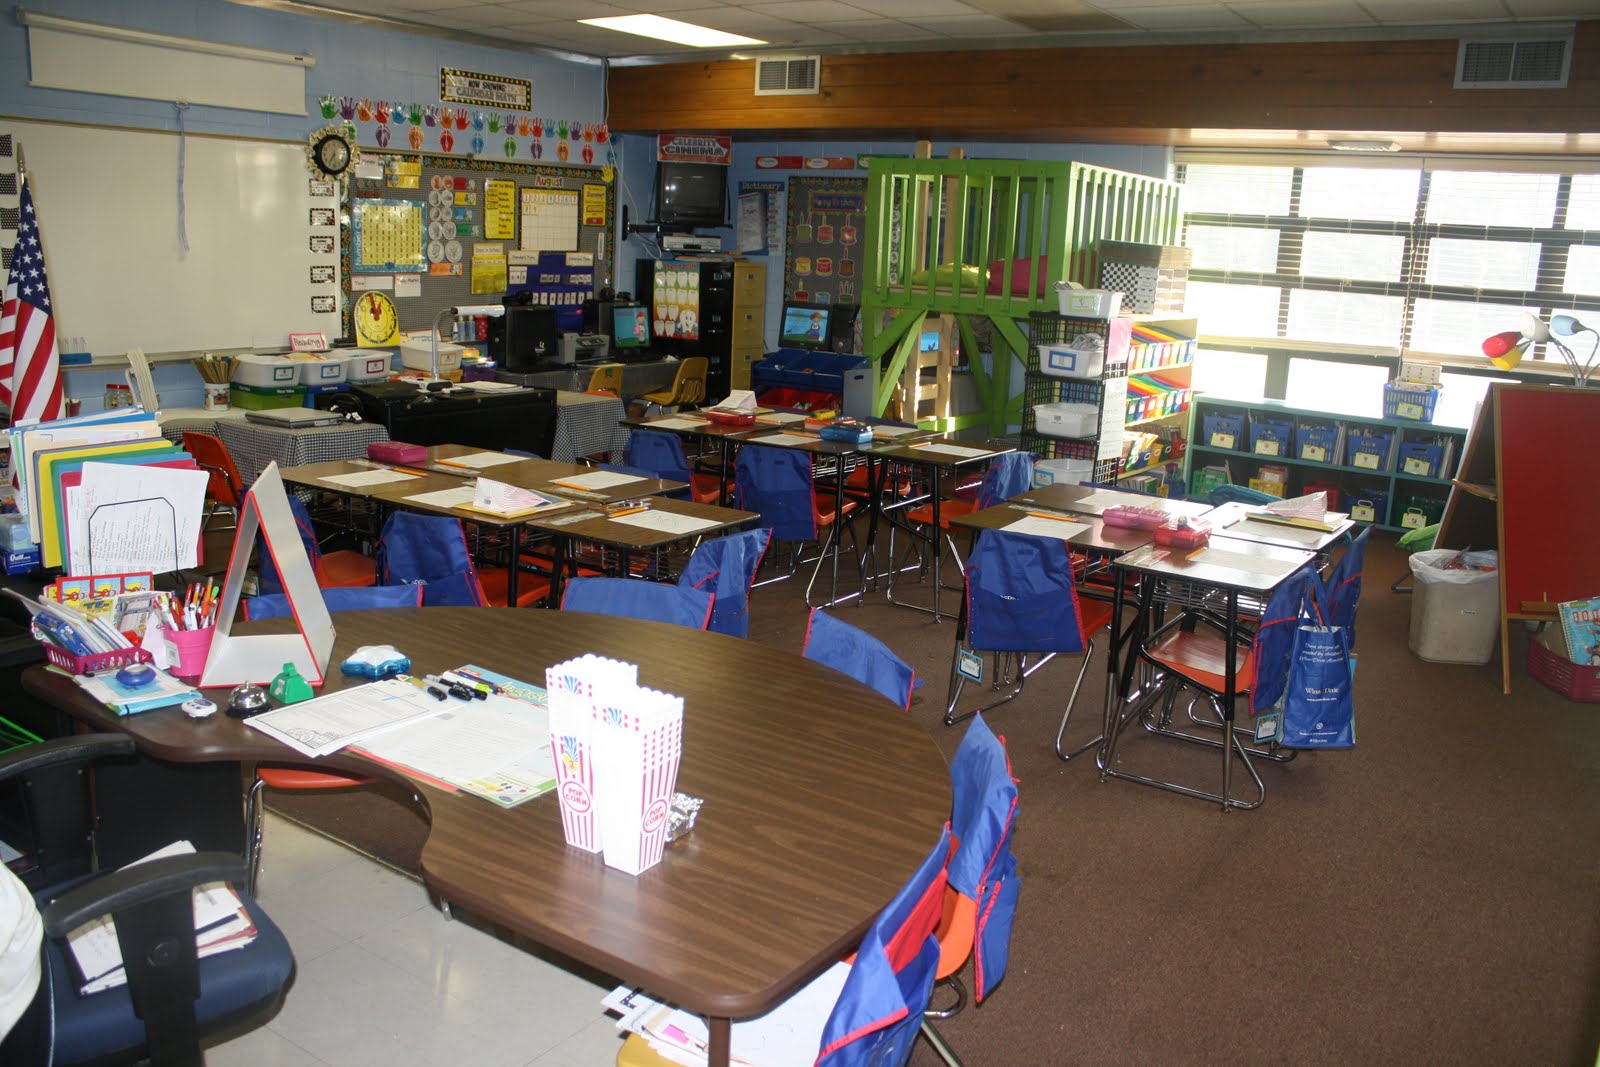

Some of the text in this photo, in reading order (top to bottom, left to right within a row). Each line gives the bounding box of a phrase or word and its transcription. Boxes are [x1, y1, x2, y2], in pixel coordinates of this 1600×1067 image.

[468, 79, 480, 88] NOW
[456, 87, 517, 103] CALENDAR MATH
[672, 137, 717, 147] CELEBRITY
[664, 145, 725, 156] CINEMA
[535, 174, 563, 188] August
[742, 182, 781, 191] Dictionary
[293, 337, 321, 347] Reading
[568, 787, 583, 797] POP
[565, 793, 587, 806] CORN
[649, 805, 663, 818] POP
[645, 812, 664, 827] CORN
